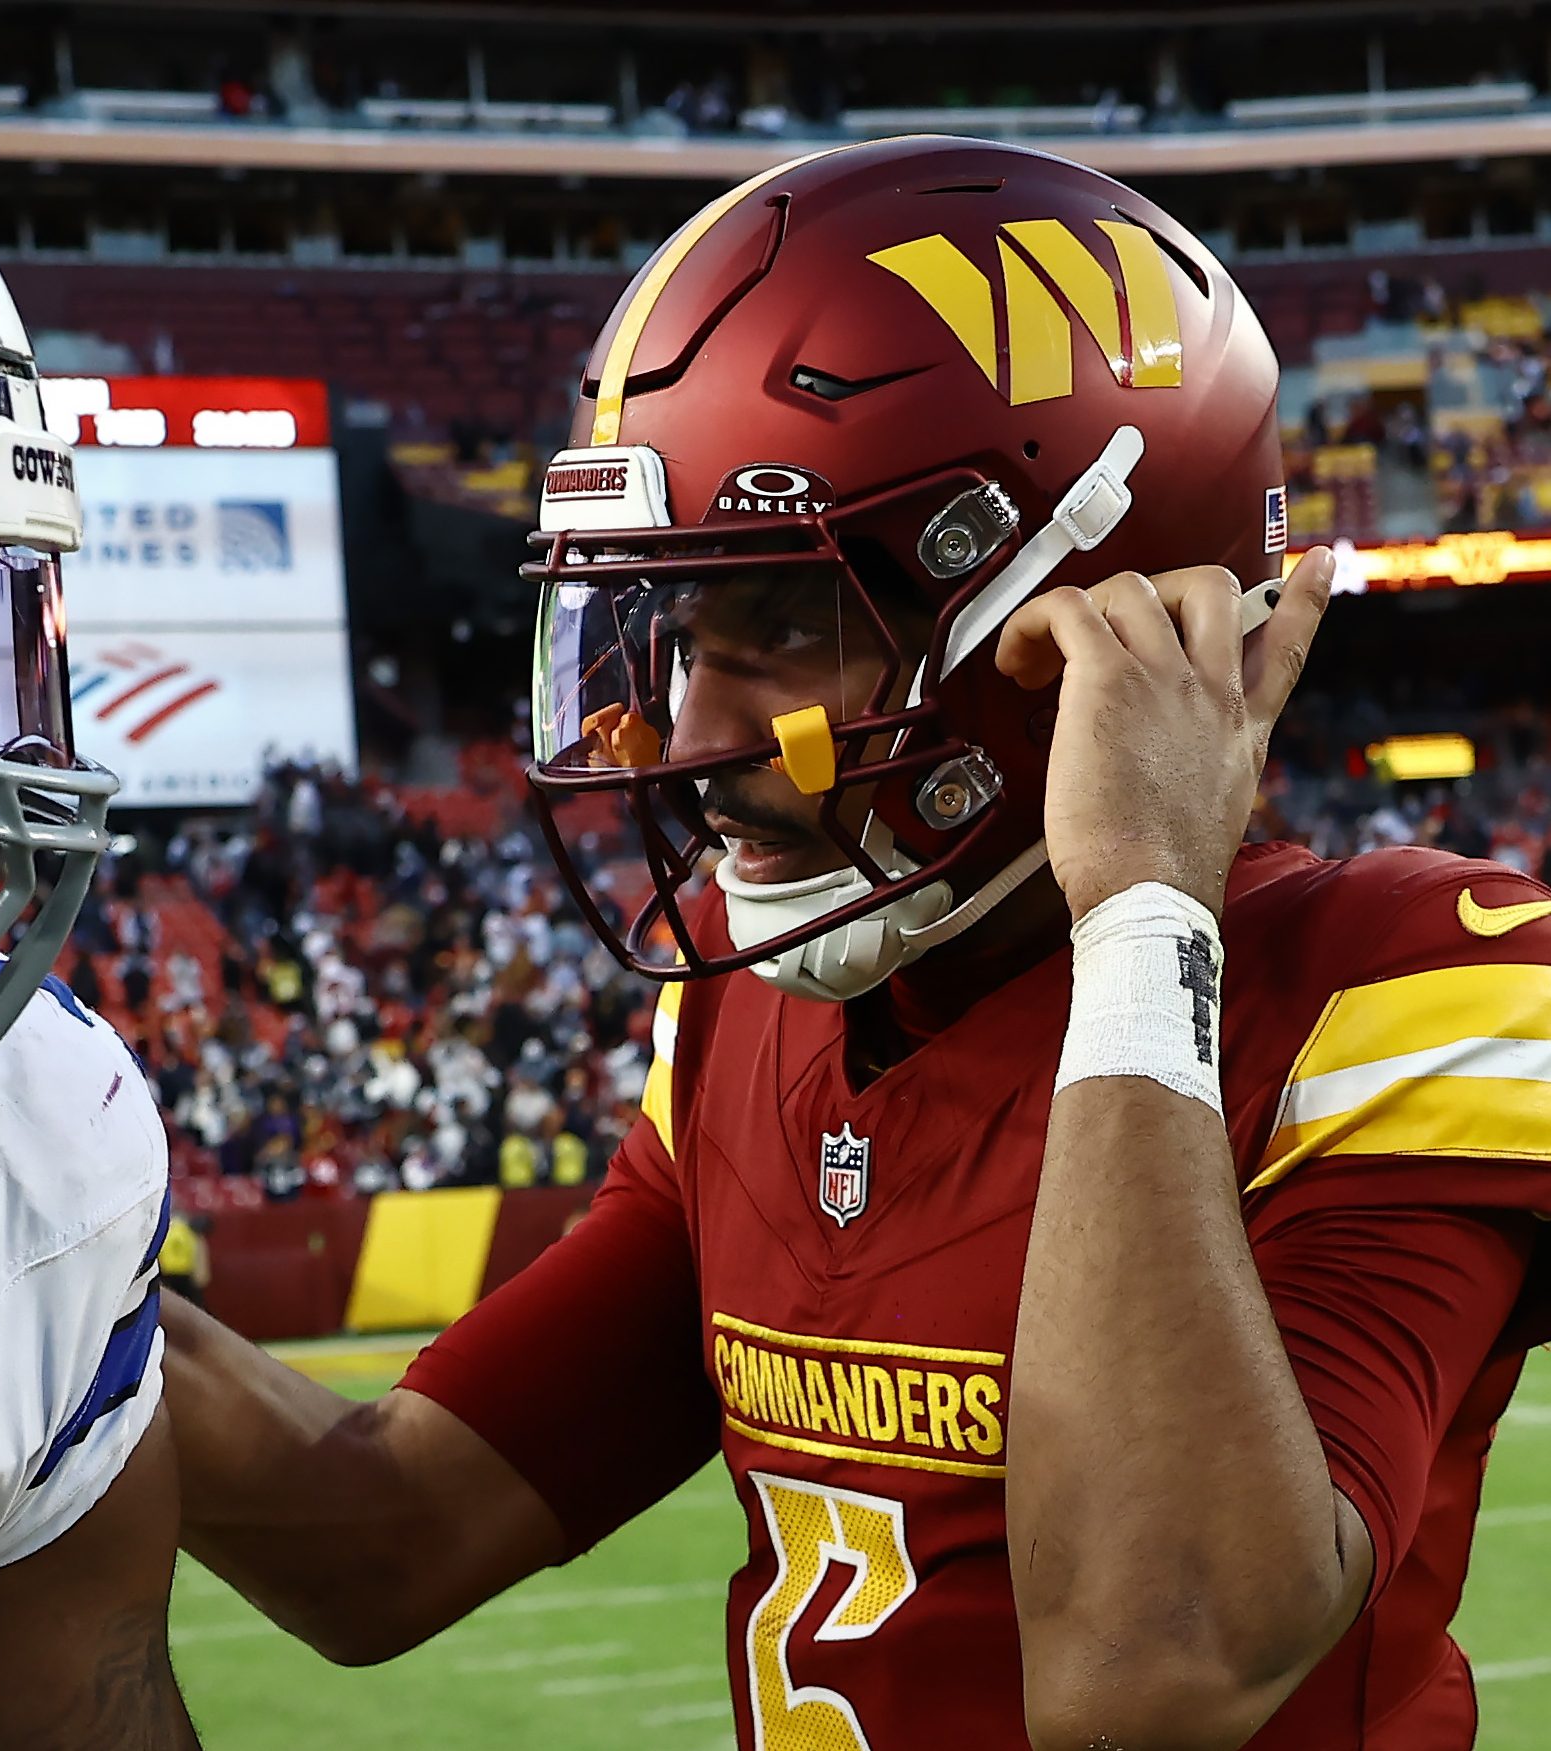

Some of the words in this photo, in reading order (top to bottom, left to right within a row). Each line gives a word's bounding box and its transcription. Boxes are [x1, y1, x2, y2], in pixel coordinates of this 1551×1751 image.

[718, 496, 827, 514] OAKLEY
[827, 1171, 859, 1208] NFL
[714, 1334, 1003, 1456] COMMANDERS
